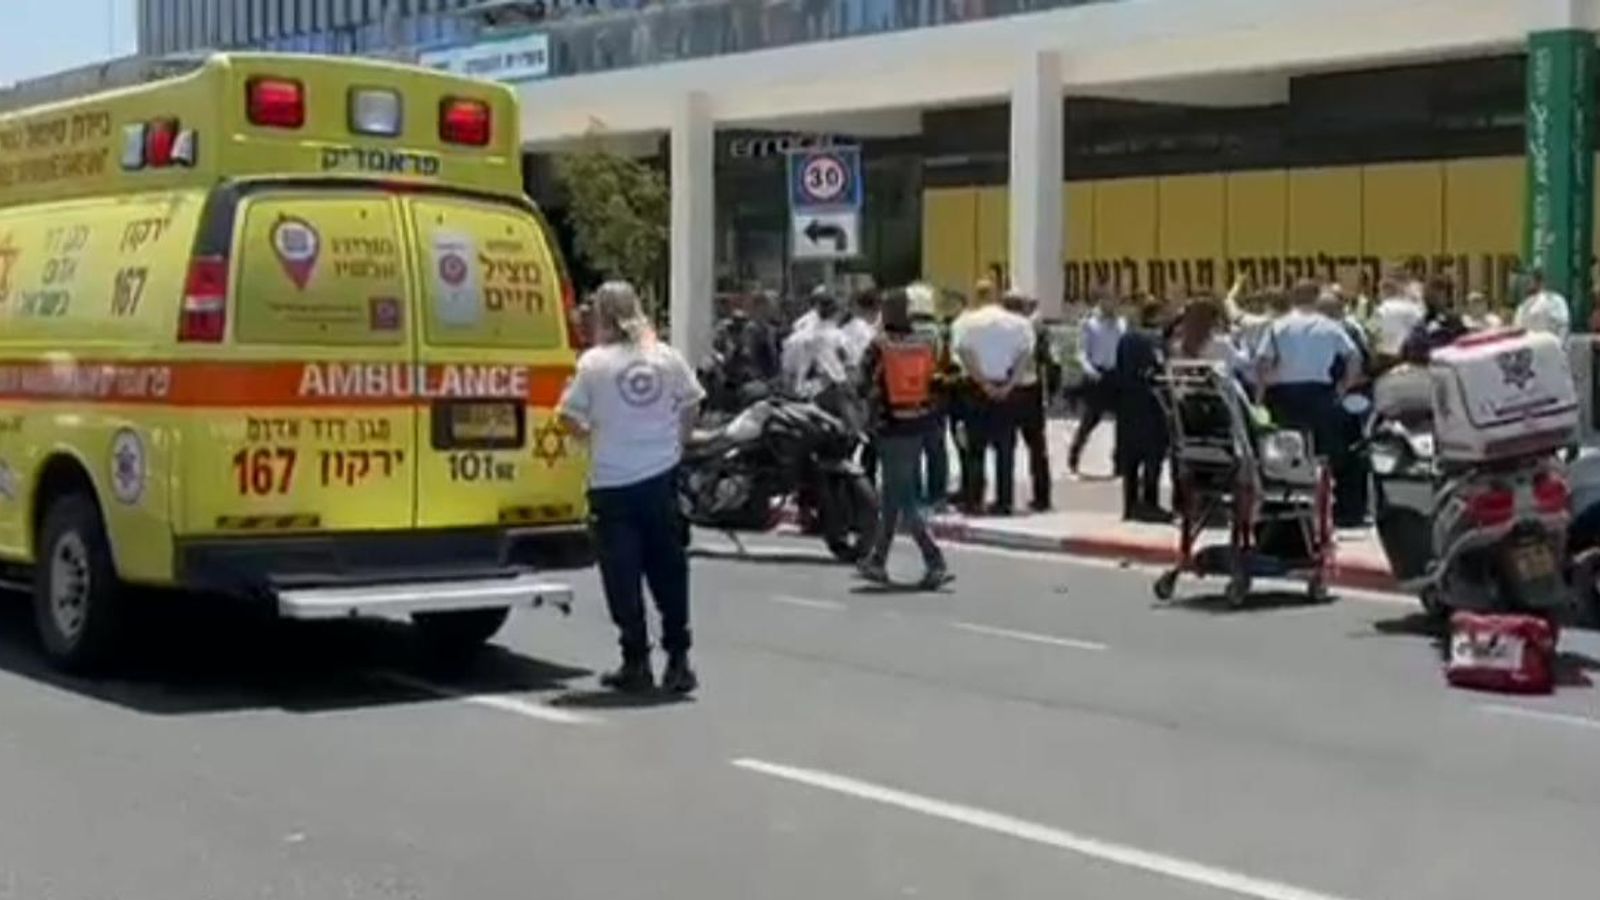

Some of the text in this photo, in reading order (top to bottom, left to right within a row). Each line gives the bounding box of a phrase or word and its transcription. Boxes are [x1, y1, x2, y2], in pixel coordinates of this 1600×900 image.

[321, 146, 438, 176] פראמדיק
[809, 165, 839, 189] 30
[119, 217, 171, 252] ירקון
[478, 250, 542, 284] מציל
[111, 265, 148, 317] 167
[485, 285, 543, 314] חיים
[298, 362, 530, 397] AMBULANCE
[247, 415, 391, 444] מגן דוד אדום
[233, 446, 404, 496] ירקון 167
[449, 451, 493, 482] 101
